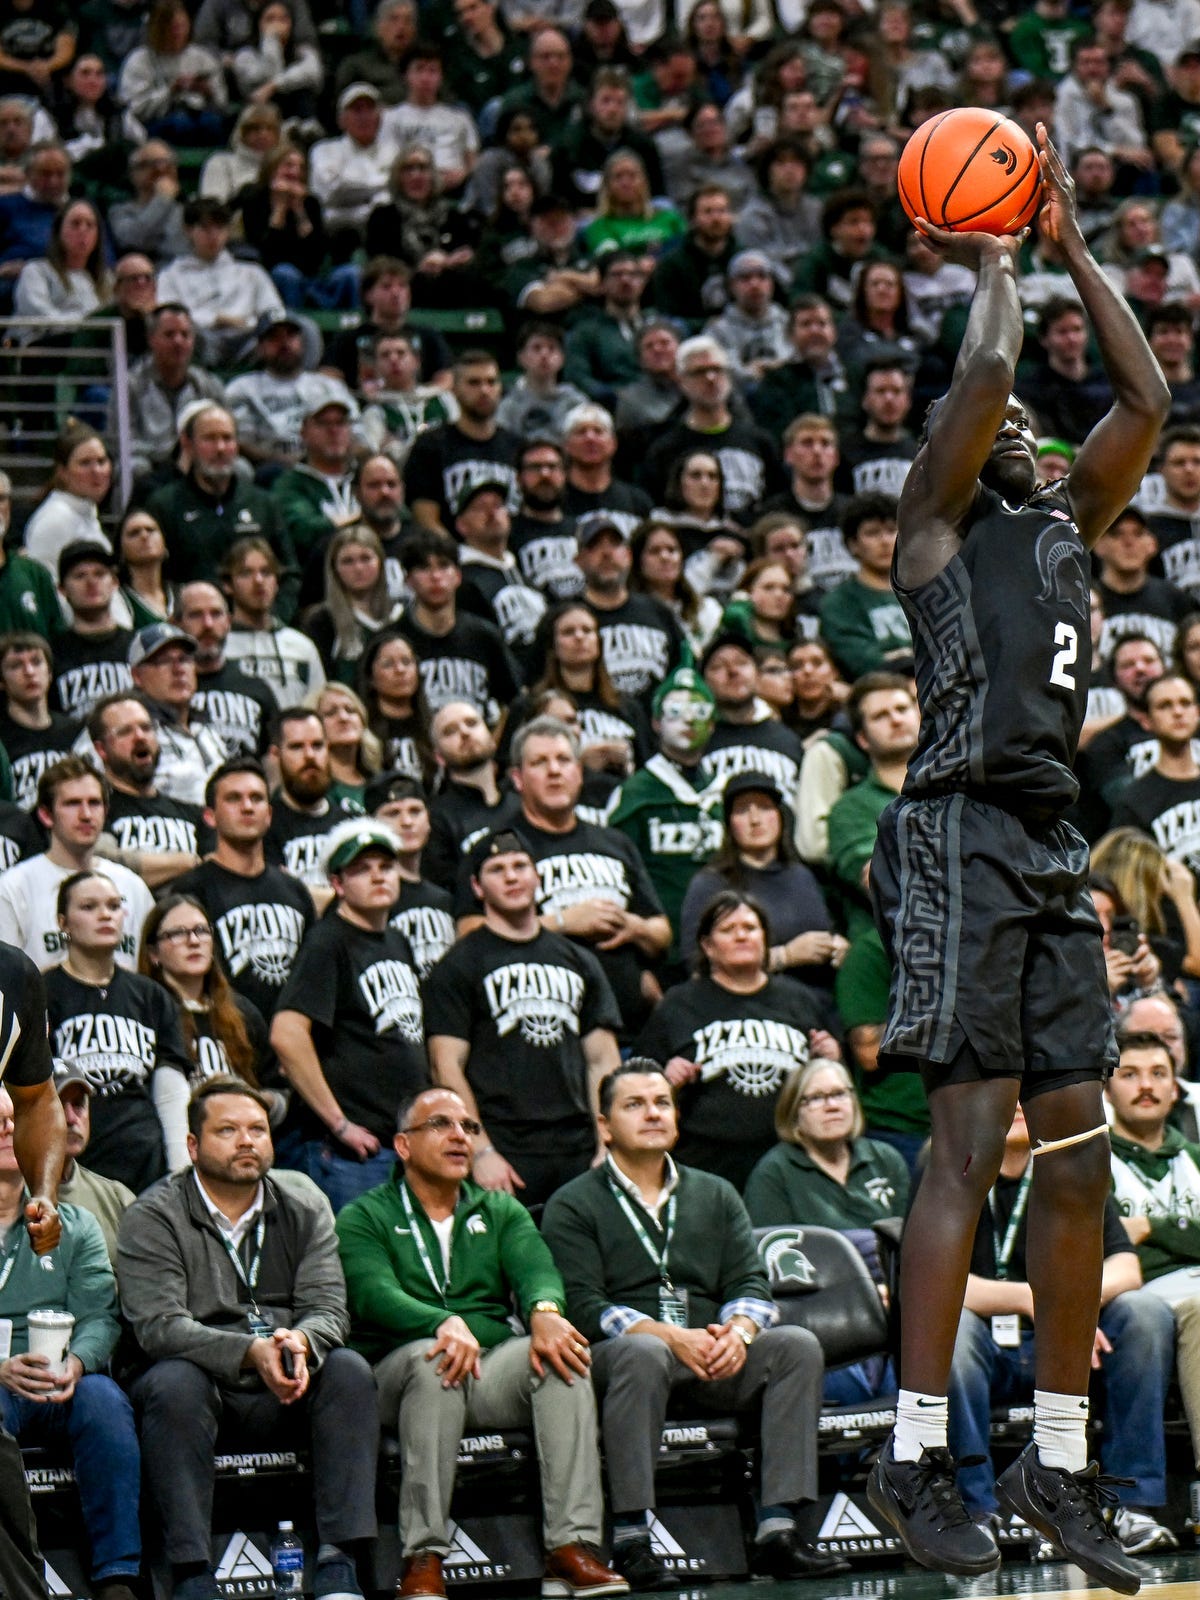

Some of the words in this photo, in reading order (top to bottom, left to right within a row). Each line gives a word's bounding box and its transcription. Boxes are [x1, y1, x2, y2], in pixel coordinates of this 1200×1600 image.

[600, 624, 669, 672] ZONE
[1050, 621, 1079, 691] 2
[57, 661, 134, 712] IZZON
[420, 657, 488, 700] ZONE
[535, 853, 632, 902] ZZONE
[217, 903, 305, 958] IZZON
[484, 963, 586, 1019] IZZONE
[56, 1013, 157, 1070] IZZONE
[694, 1019, 811, 1068] IZZONE
[460, 1435, 506, 1453] TANS
[662, 1427, 708, 1444] TANS
[818, 1410, 897, 1432] SPARTANS
[214, 1452, 297, 1468] SPARTANS
[442, 1564, 505, 1580] RISURE
